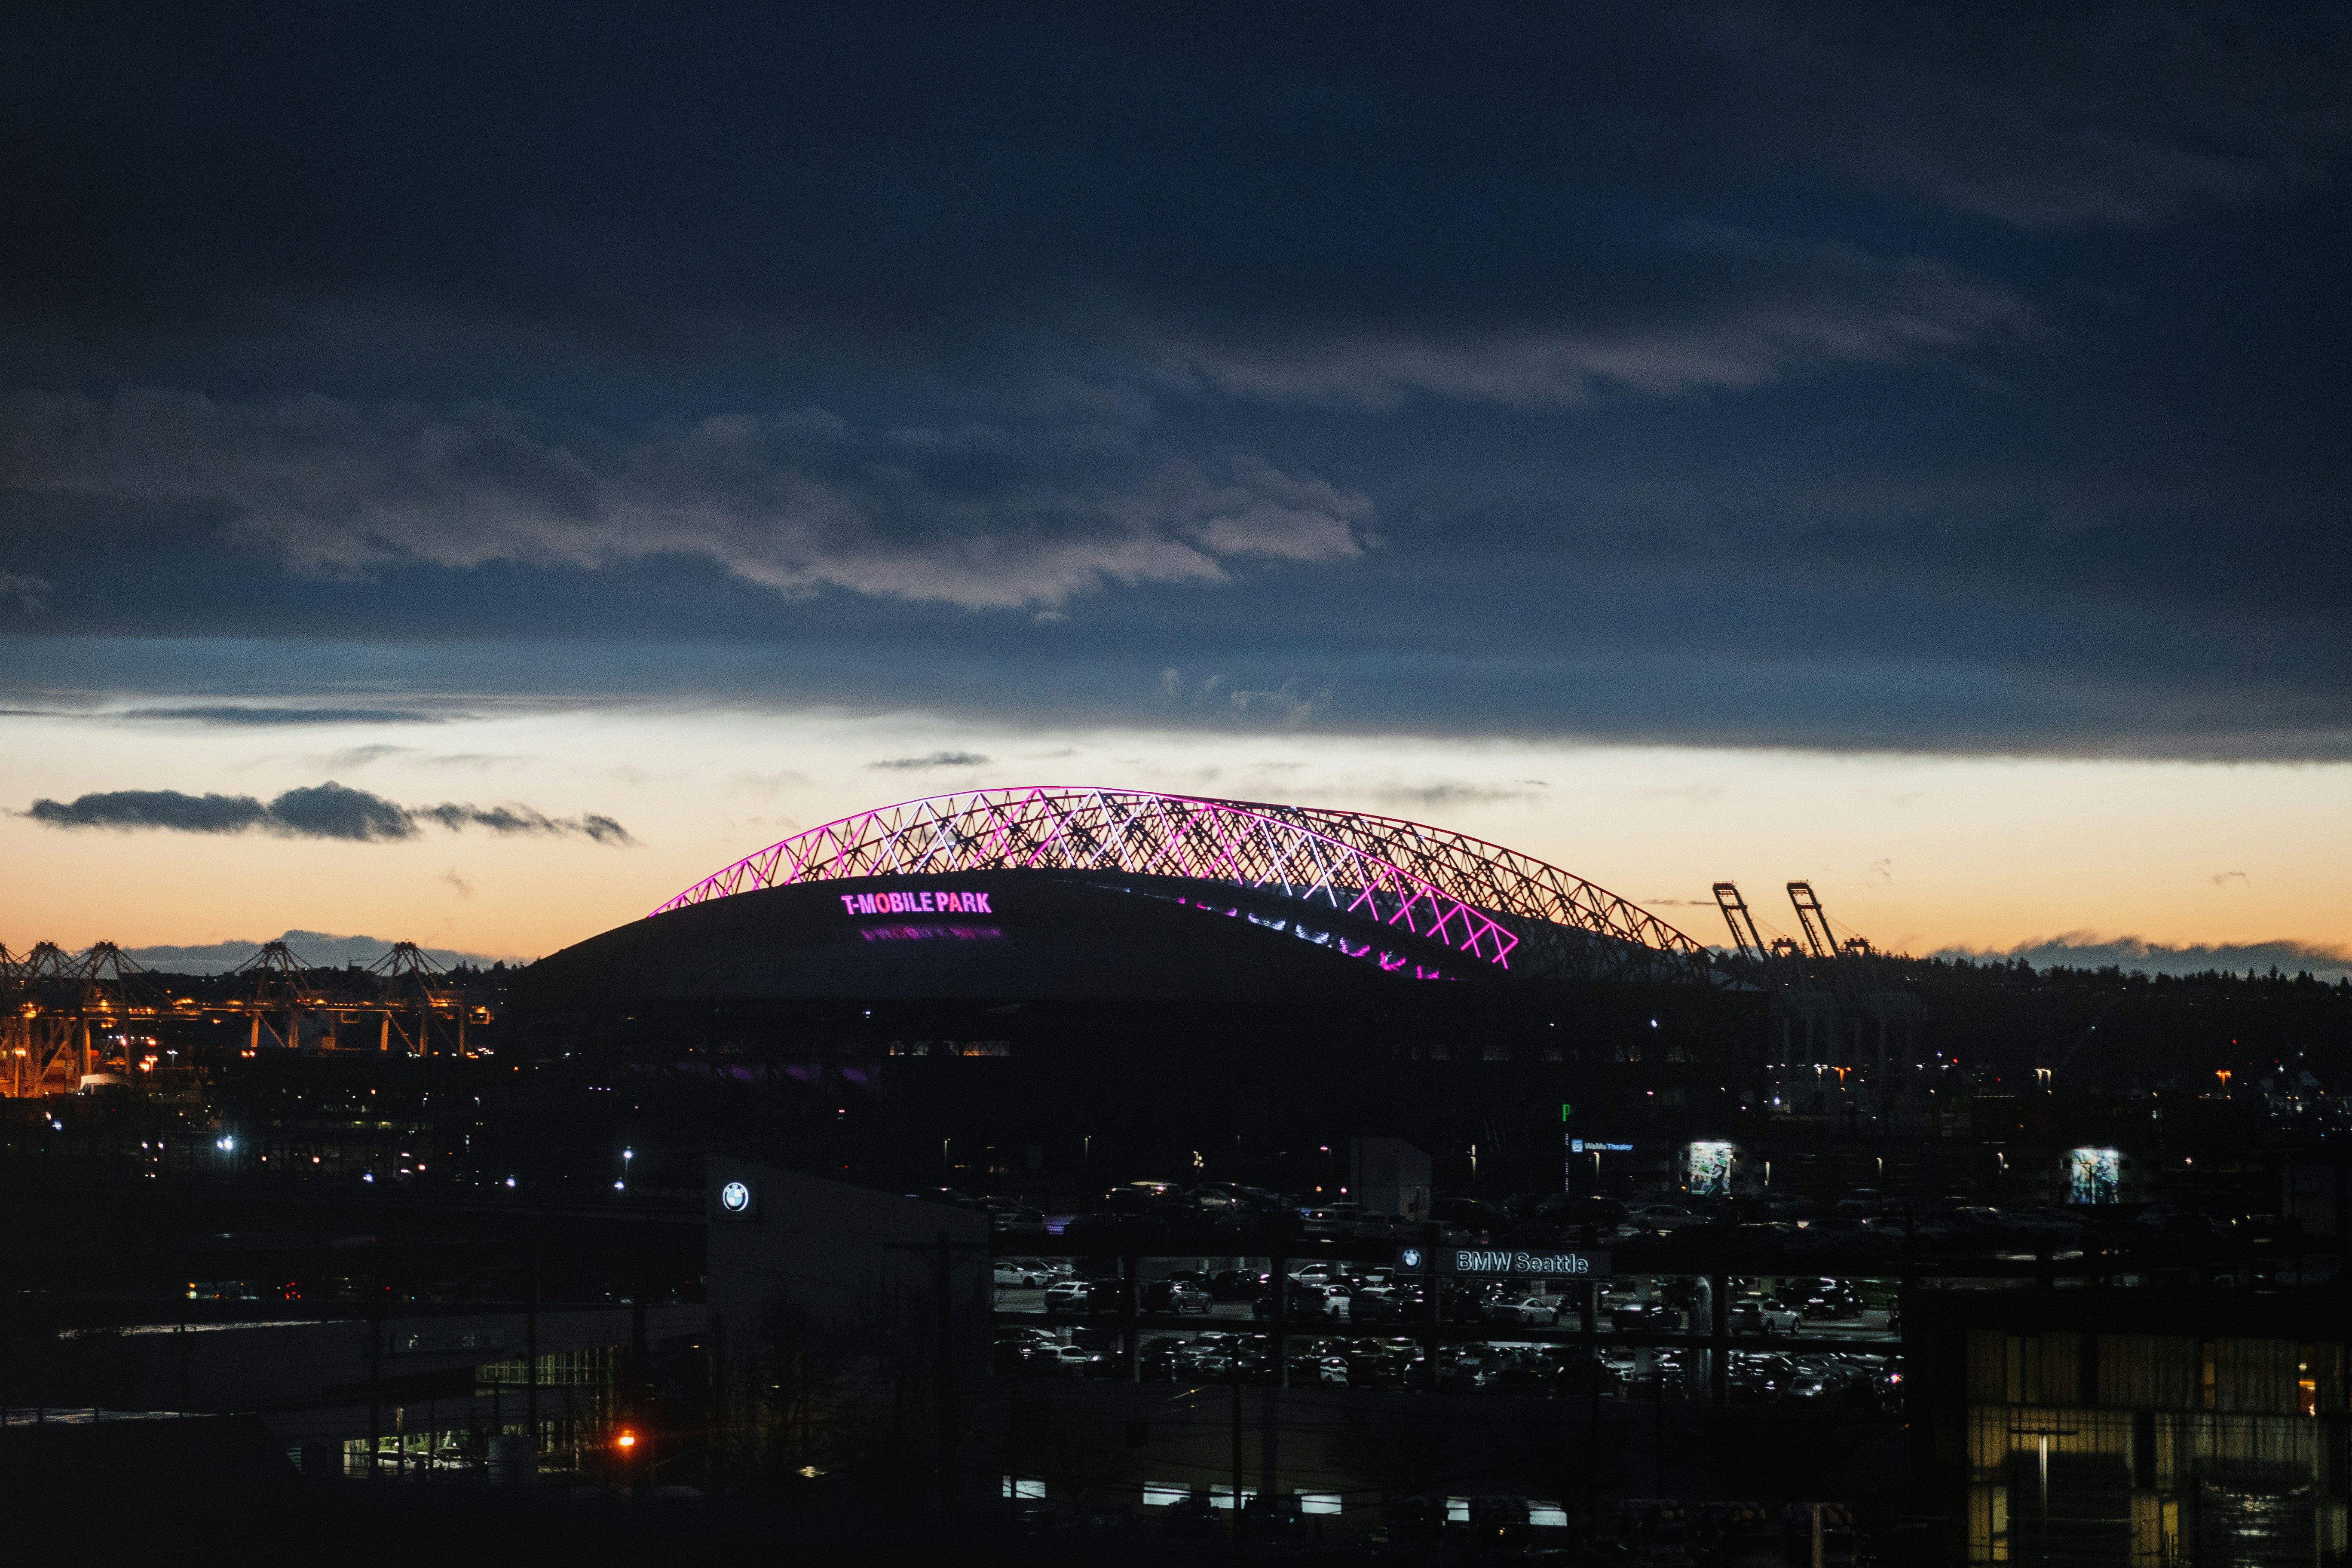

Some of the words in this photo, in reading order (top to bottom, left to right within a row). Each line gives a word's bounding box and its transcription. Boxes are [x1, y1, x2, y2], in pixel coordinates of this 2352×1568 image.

[840, 891, 935, 915] T-MOBILE
[935, 891, 992, 914] PARK
[1562, 1104, 1571, 1121] P
[1456, 1251, 1512, 1271] BMW
[1514, 1252, 1589, 1274] Seattle
